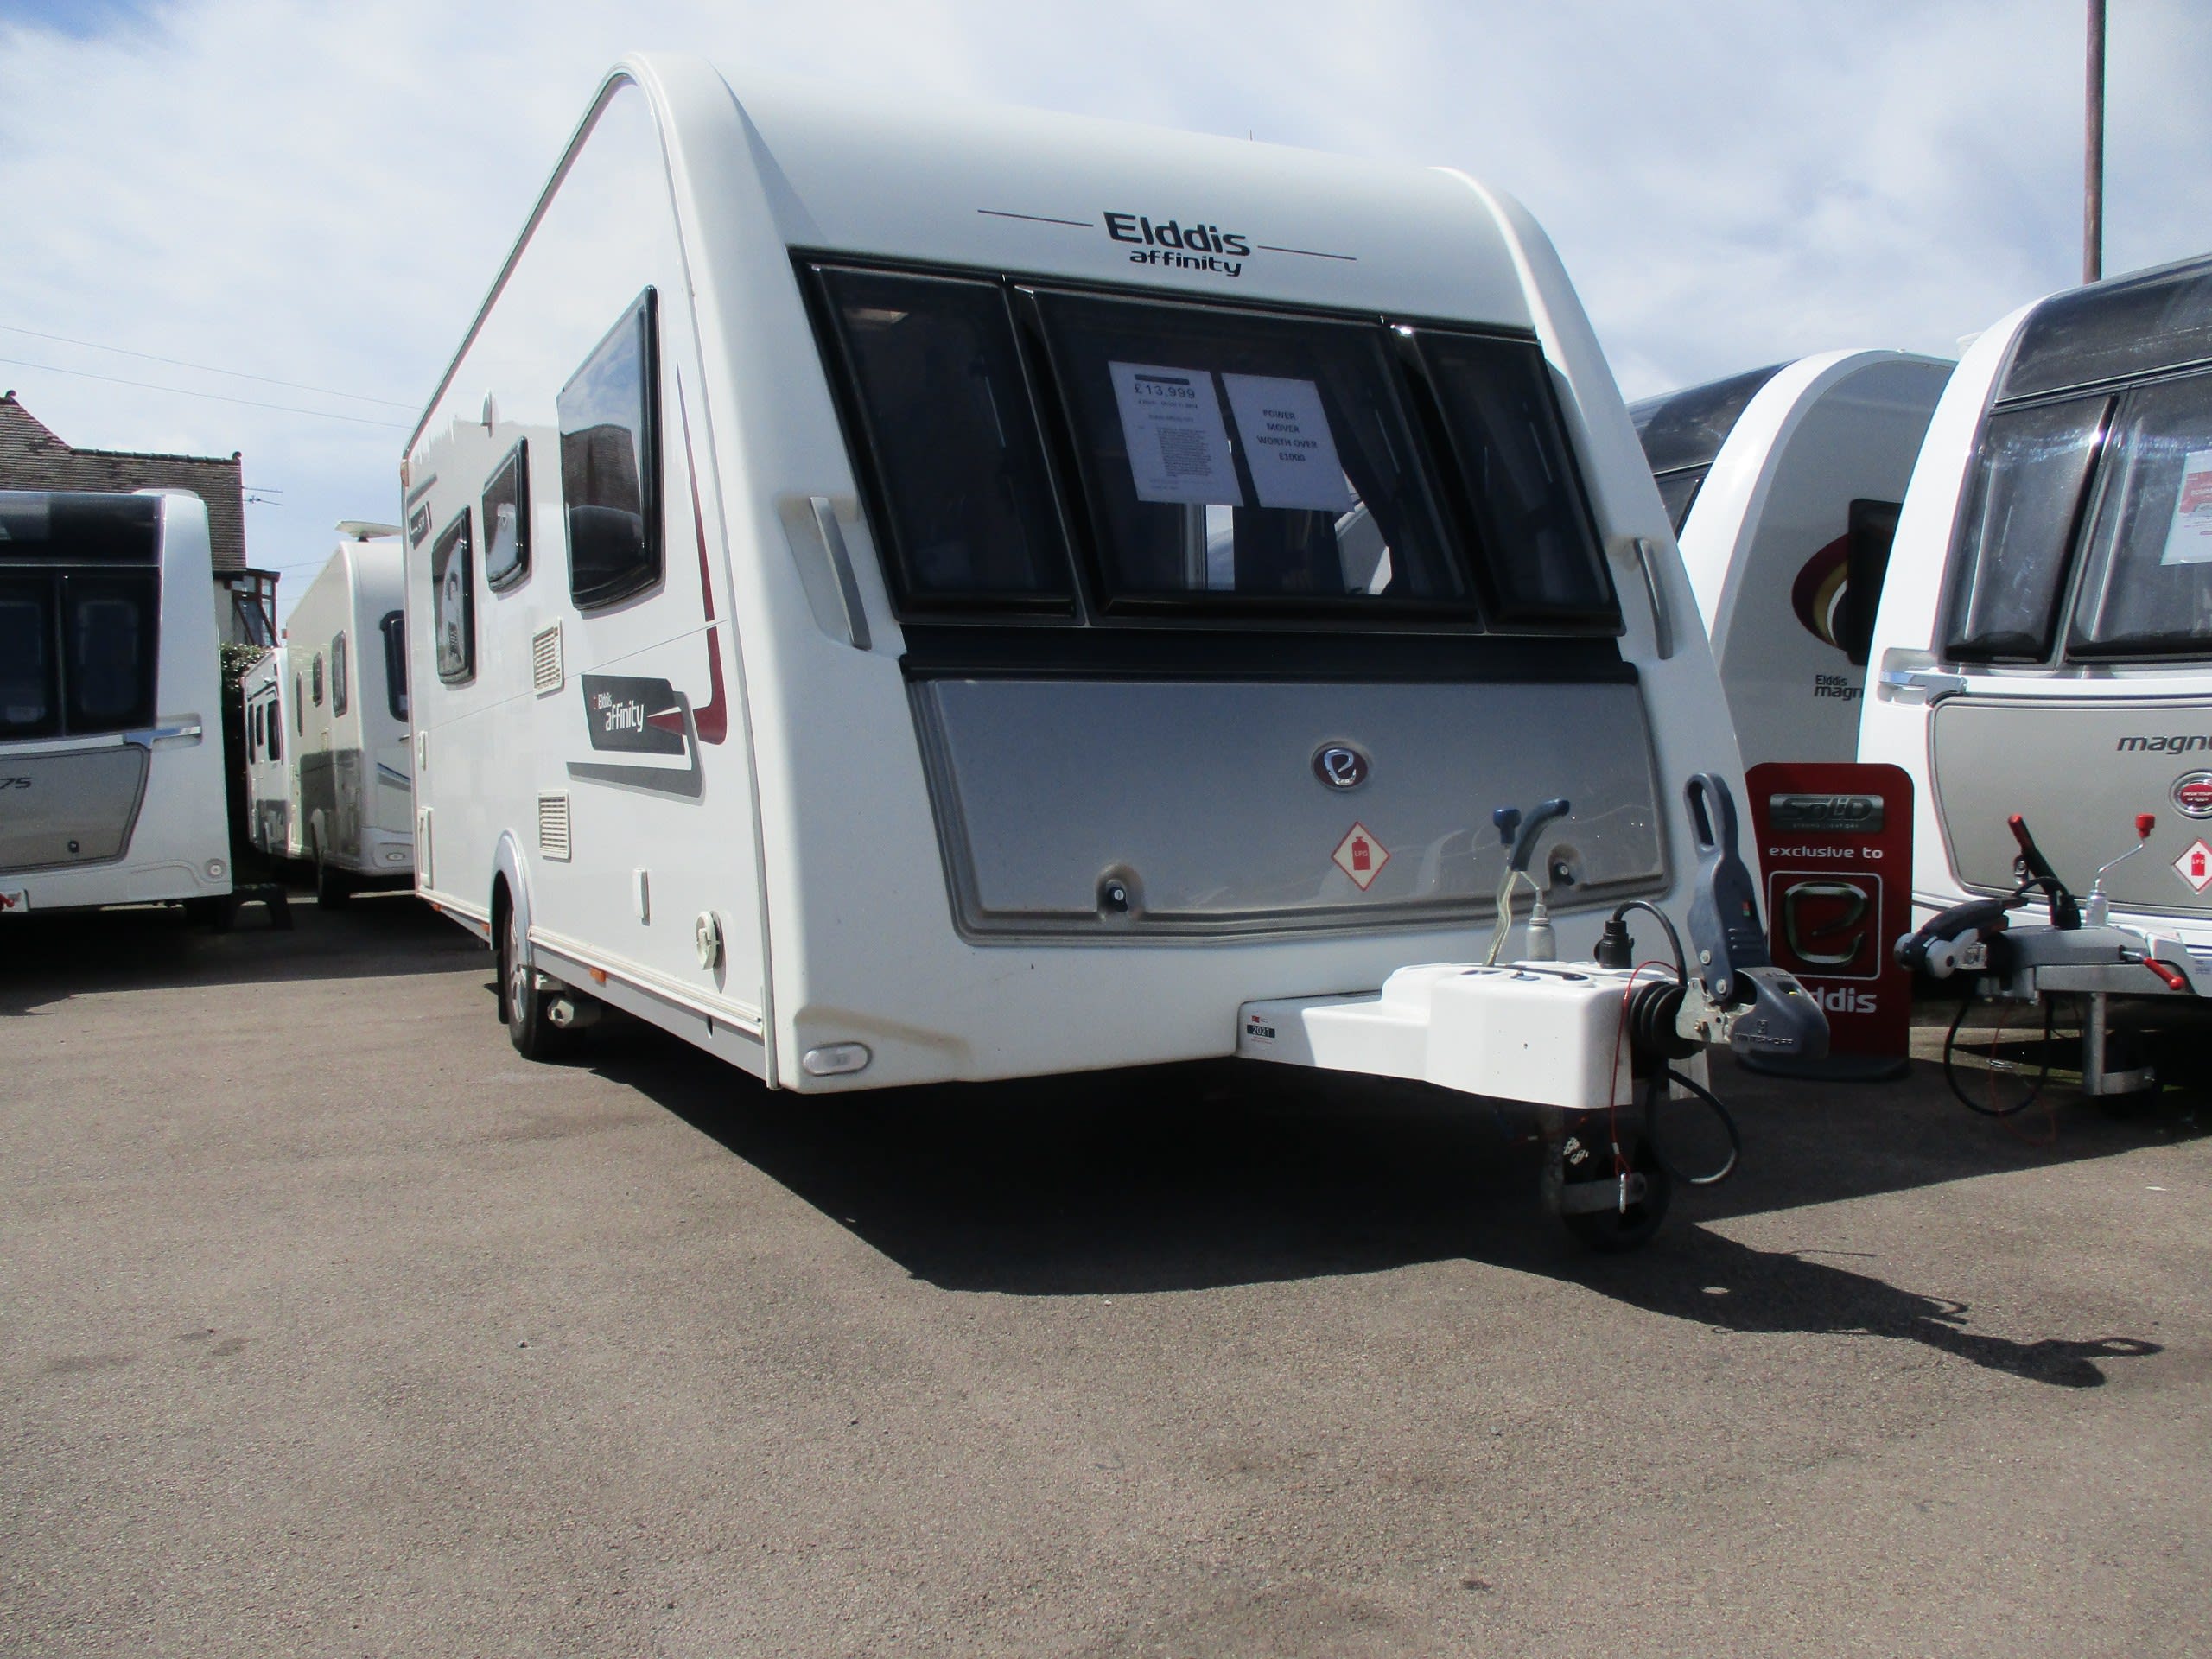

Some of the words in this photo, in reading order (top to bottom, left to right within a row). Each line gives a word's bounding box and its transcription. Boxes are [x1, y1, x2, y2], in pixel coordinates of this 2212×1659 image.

[1102, 211, 1250, 257] Elddis
[1129, 250, 1242, 277] affinity
[1262, 409, 1296, 420] POWER
[1266, 423, 1300, 434] MOVER
[1256, 435, 1292, 446] WORTH
[1293, 438, 1318, 448] OVER
[1815, 675, 1847, 686] Elddis
[605, 700, 645, 733] affinity
[1769, 845, 1854, 859] exclusive
[1863, 847, 1884, 859] to
